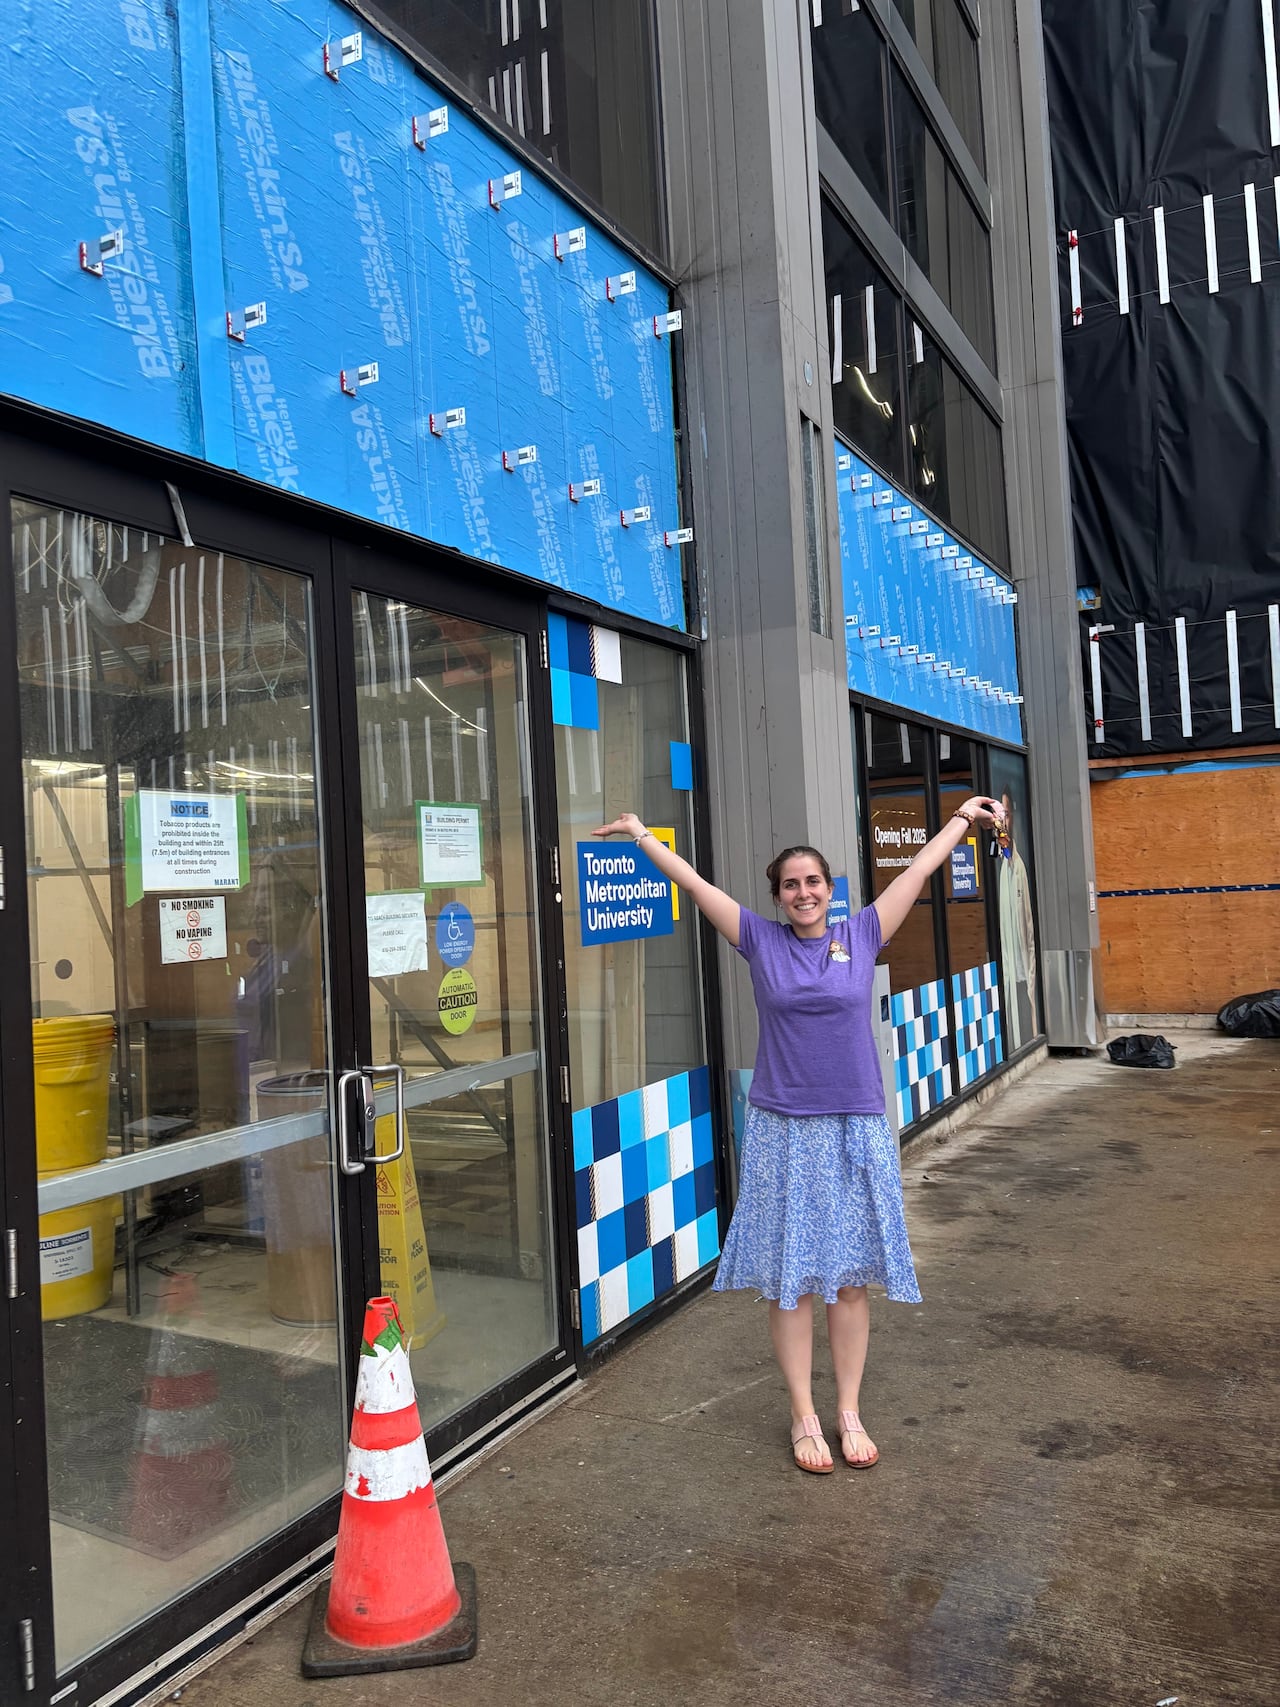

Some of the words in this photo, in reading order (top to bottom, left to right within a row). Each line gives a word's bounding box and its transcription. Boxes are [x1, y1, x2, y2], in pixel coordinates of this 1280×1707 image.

[258, 100, 278, 154] Henry
[270, 398, 298, 450] Henry
[171, 804, 209, 815] NOTICE
[160, 820, 184, 828] Tobacco
[185, 821, 210, 829] products
[161, 830, 191, 838] prohibited
[874, 826, 901, 848] Opening
[900, 827, 912, 844] Fall
[912, 828, 927, 844] 2025
[158, 839, 182, 848] building
[182, 839, 194, 847] and
[195, 839, 213, 847] within
[178, 849, 202, 857] building
[199, 858, 217, 866] during
[583, 853, 636, 876] Toronto
[174, 867, 211, 875] construction
[586, 878, 667, 906] Metropolitan
[171, 901, 182, 911] NO
[182, 899, 214, 910] SMOKING
[587, 904, 654, 931] University
[176, 929, 186, 939] NO
[186, 927, 213, 938] VAPING
[442, 982, 474, 994] AUTOMATIC
[440, 992, 477, 1010] CAUTION
[450, 1010, 468, 1020] DOOR
